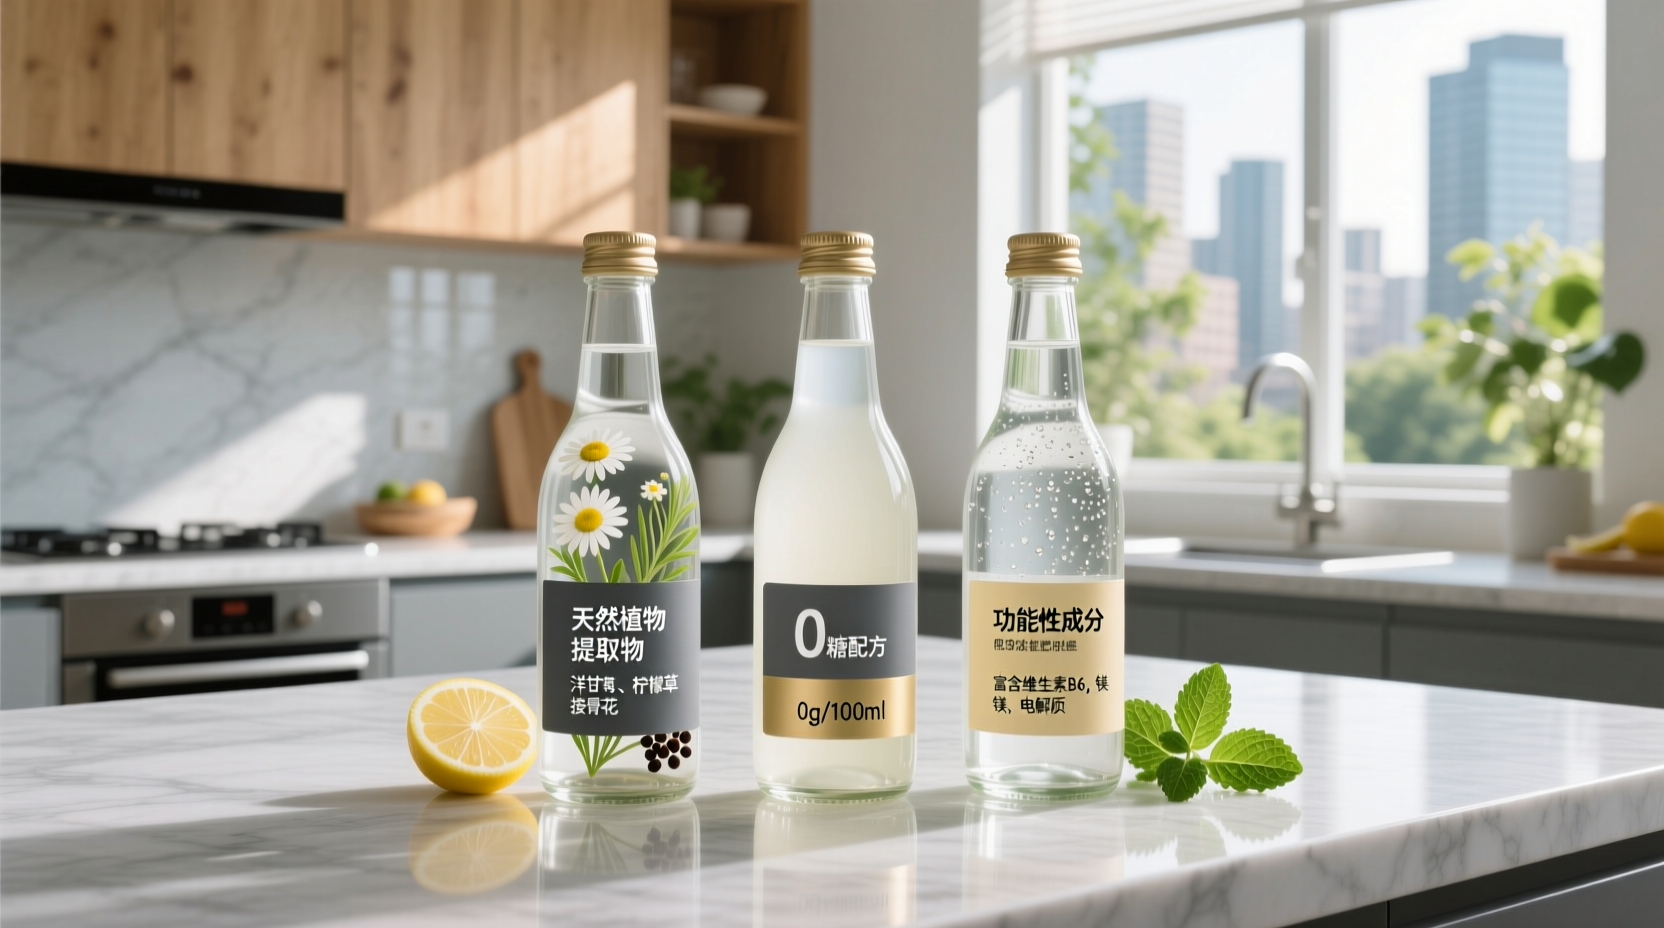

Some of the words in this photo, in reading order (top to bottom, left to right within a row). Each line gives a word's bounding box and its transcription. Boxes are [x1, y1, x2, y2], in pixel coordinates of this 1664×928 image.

[571, 605, 666, 632] 天然植物
[993, 606, 1104, 633] 功能性成分
[570, 636, 645, 663] 提取物
[797, 700, 885, 726] 0g/100ml
